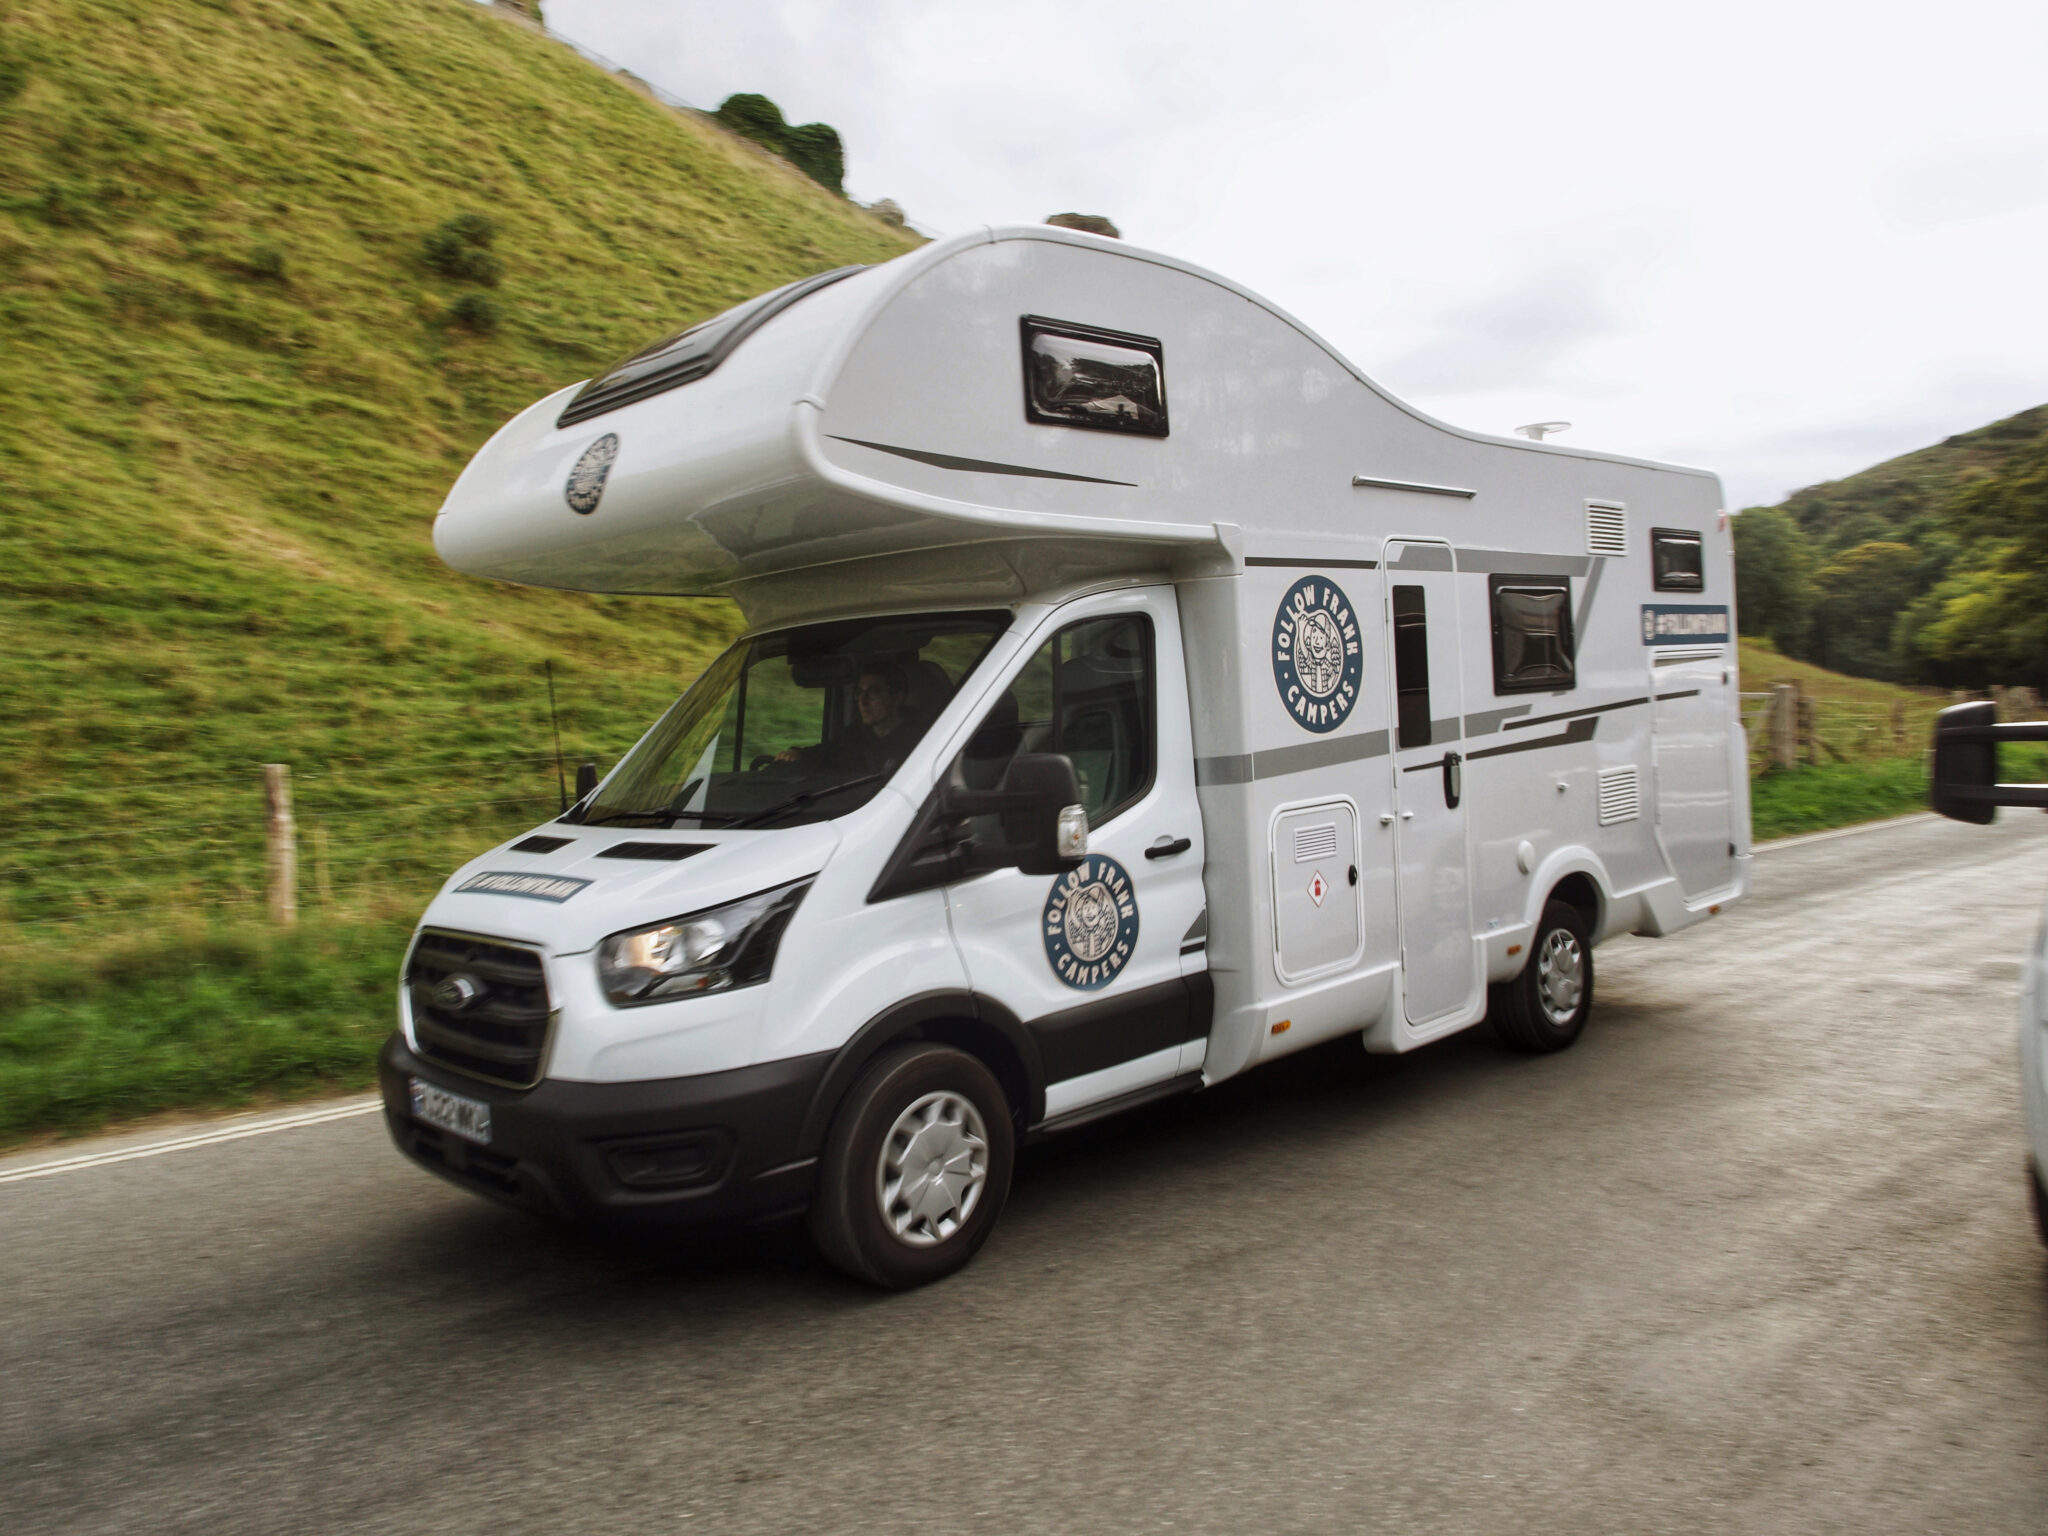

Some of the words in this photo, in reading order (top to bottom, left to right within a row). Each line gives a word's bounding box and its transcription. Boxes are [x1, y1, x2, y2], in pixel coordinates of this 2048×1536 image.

[1277, 584, 1315, 661] FOLLOW
[1322, 587, 1358, 656] FRANK
[1287, 680, 1354, 725] CAMPERS
[1047, 862, 1090, 936] FOLLOW
[1097, 862, 1134, 919] FRANK
[1057, 940, 1129, 986] CAMPERS
